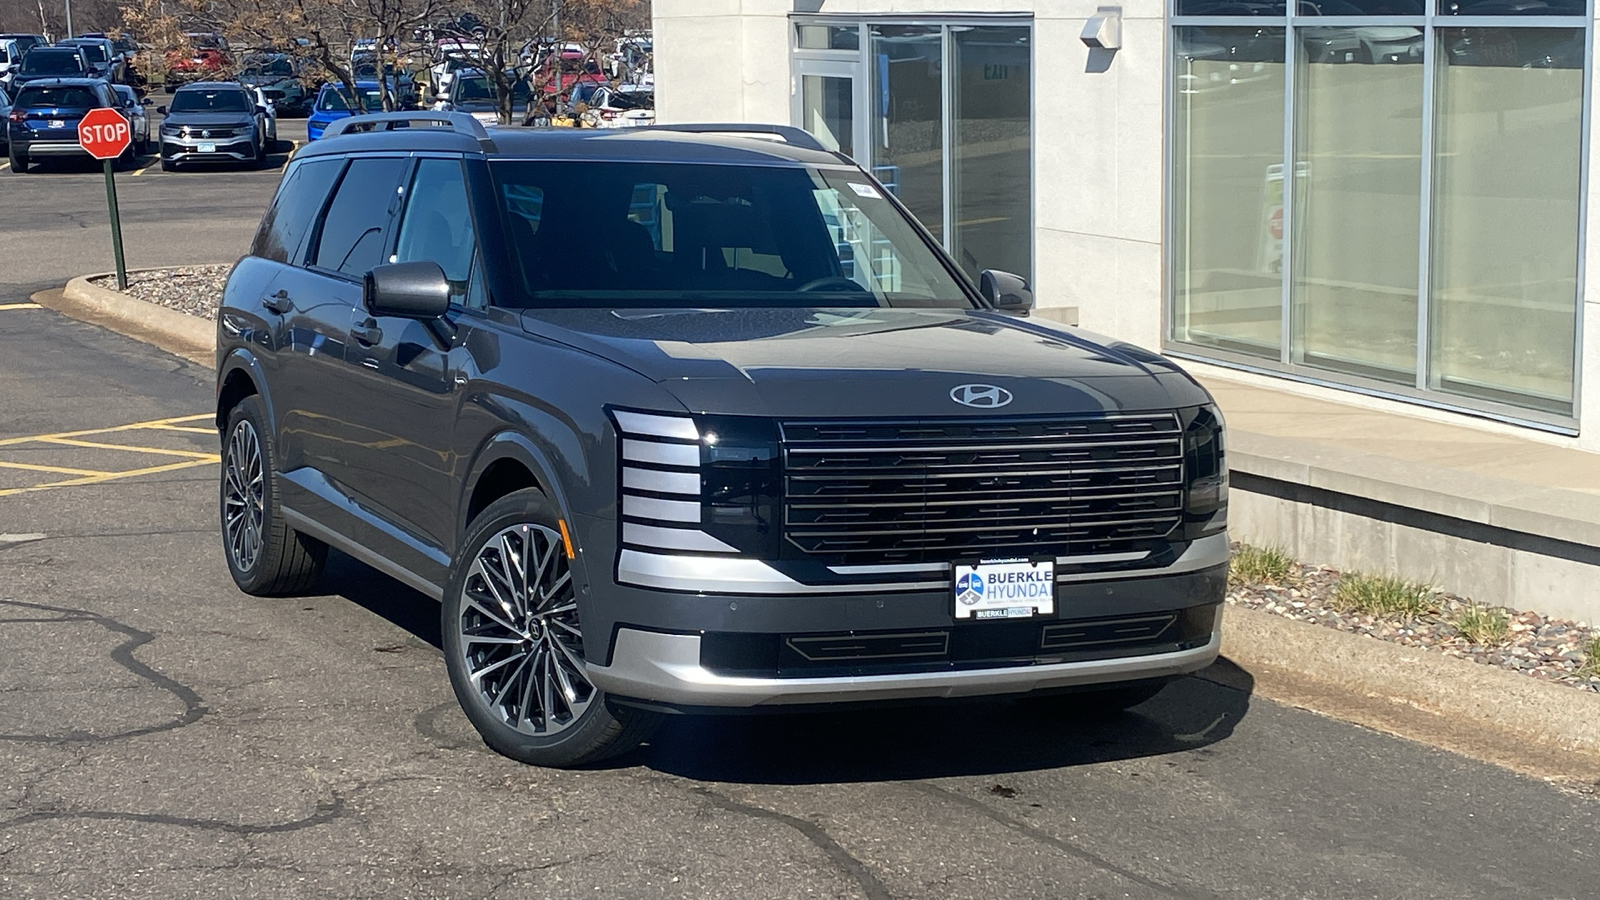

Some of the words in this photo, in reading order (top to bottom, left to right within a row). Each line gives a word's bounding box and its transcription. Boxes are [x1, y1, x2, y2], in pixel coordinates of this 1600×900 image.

[82, 122, 127, 144] STOP
[988, 571, 1052, 584] BUERKLE
[977, 609, 1008, 618] BUERKLE
